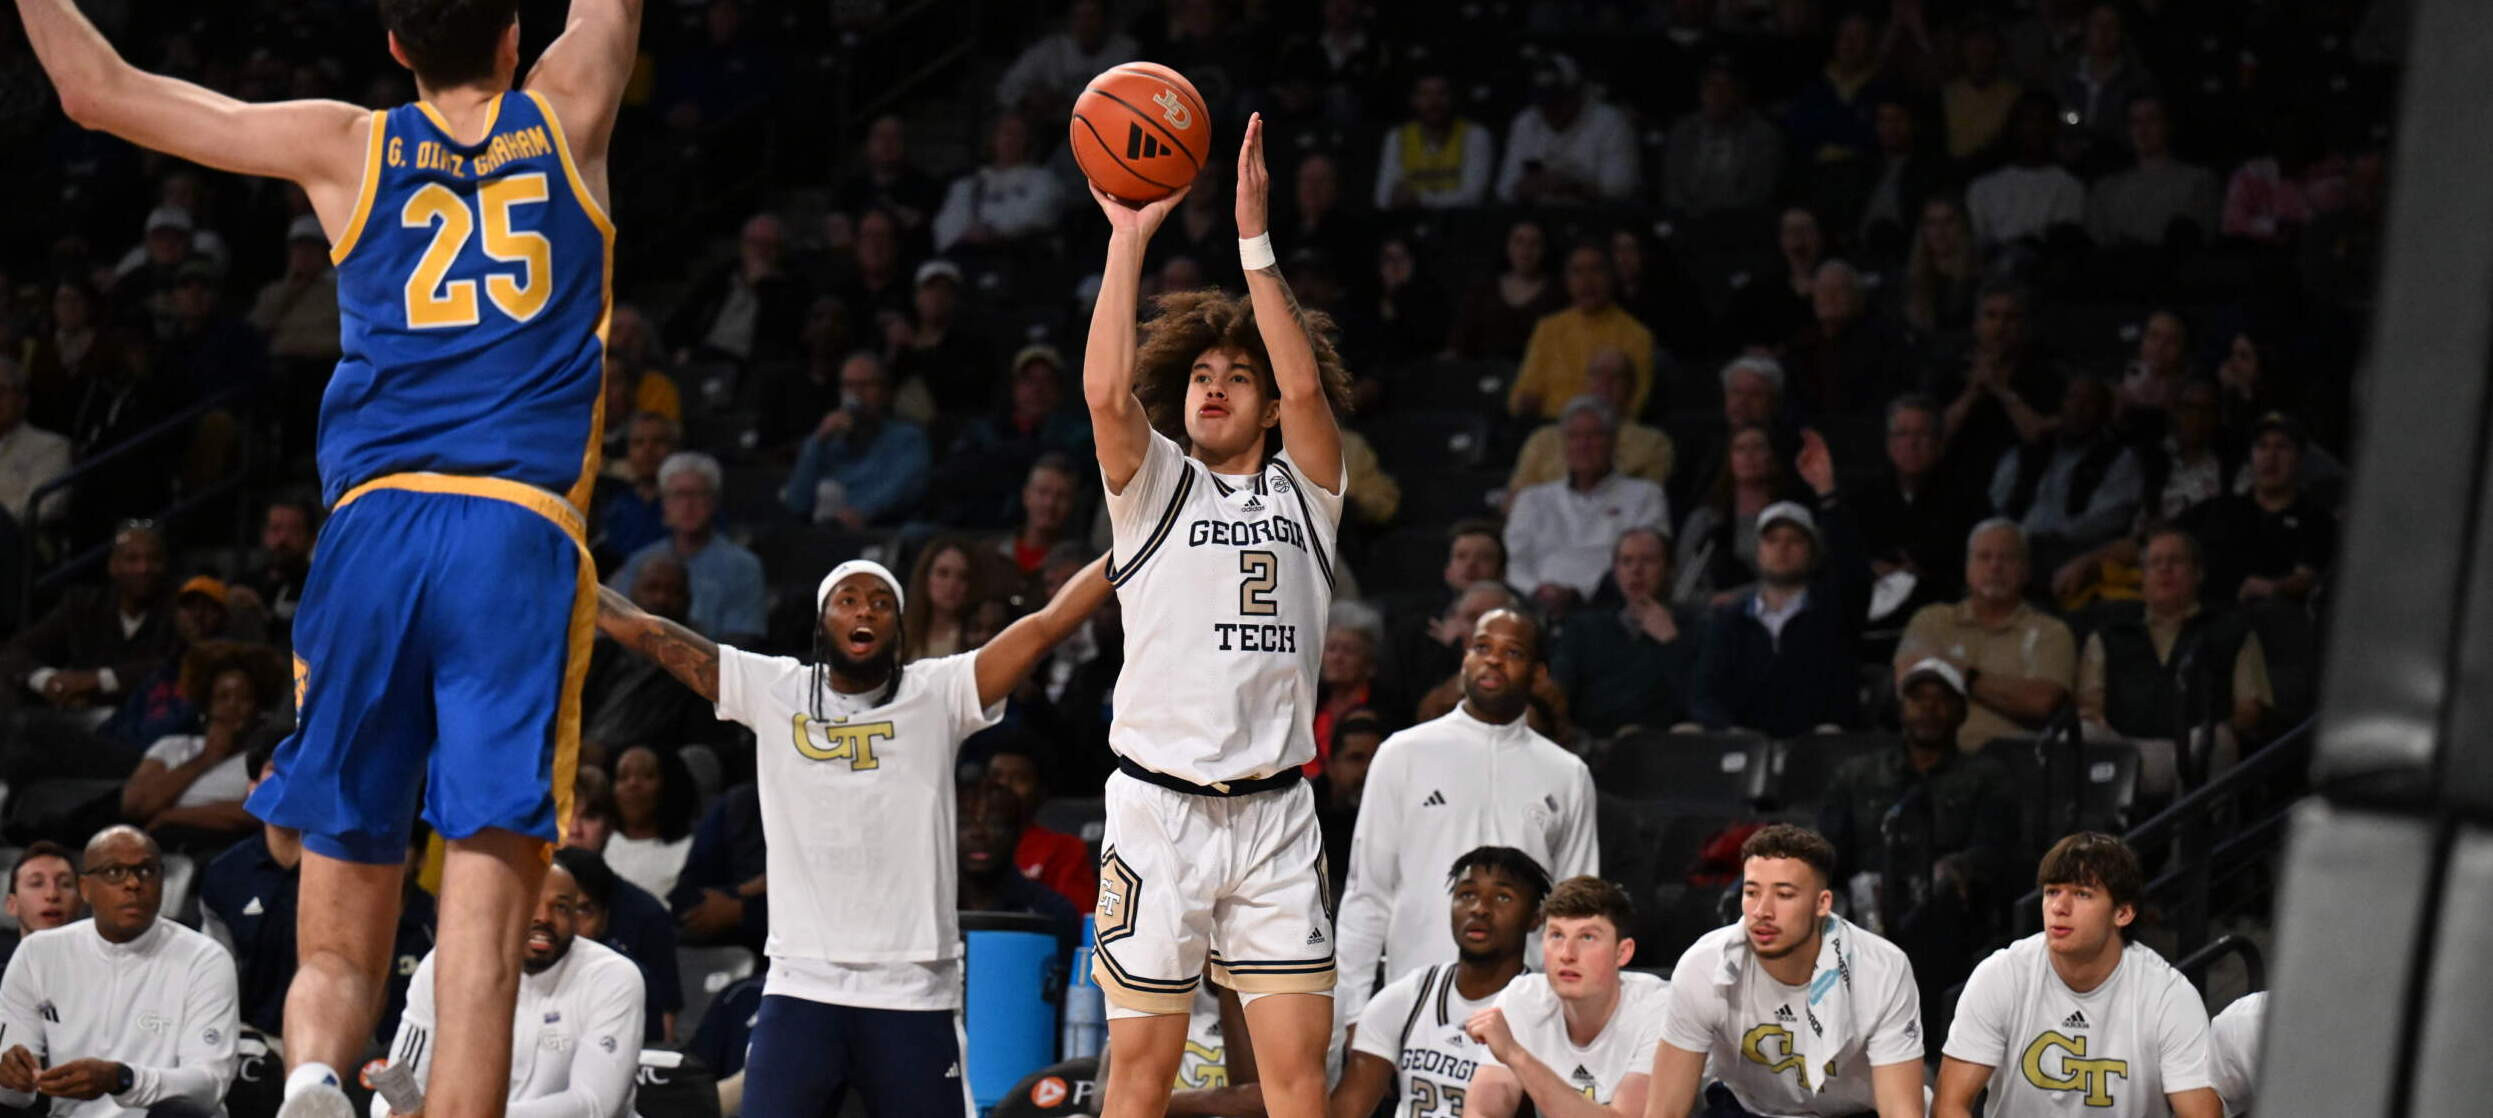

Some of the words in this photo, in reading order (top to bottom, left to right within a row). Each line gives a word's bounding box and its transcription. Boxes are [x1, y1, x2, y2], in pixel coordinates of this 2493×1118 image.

[387, 136, 407, 167] G.
[401, 171, 553, 330] 25
[1188, 515, 1308, 553] GEORGIA
[1239, 549, 1278, 616] 2
[1214, 623, 1296, 653] TECH
[792, 712, 895, 771] GT
[1401, 1049, 1479, 1082] GEORGI
[2021, 1030, 2128, 1108] GT
